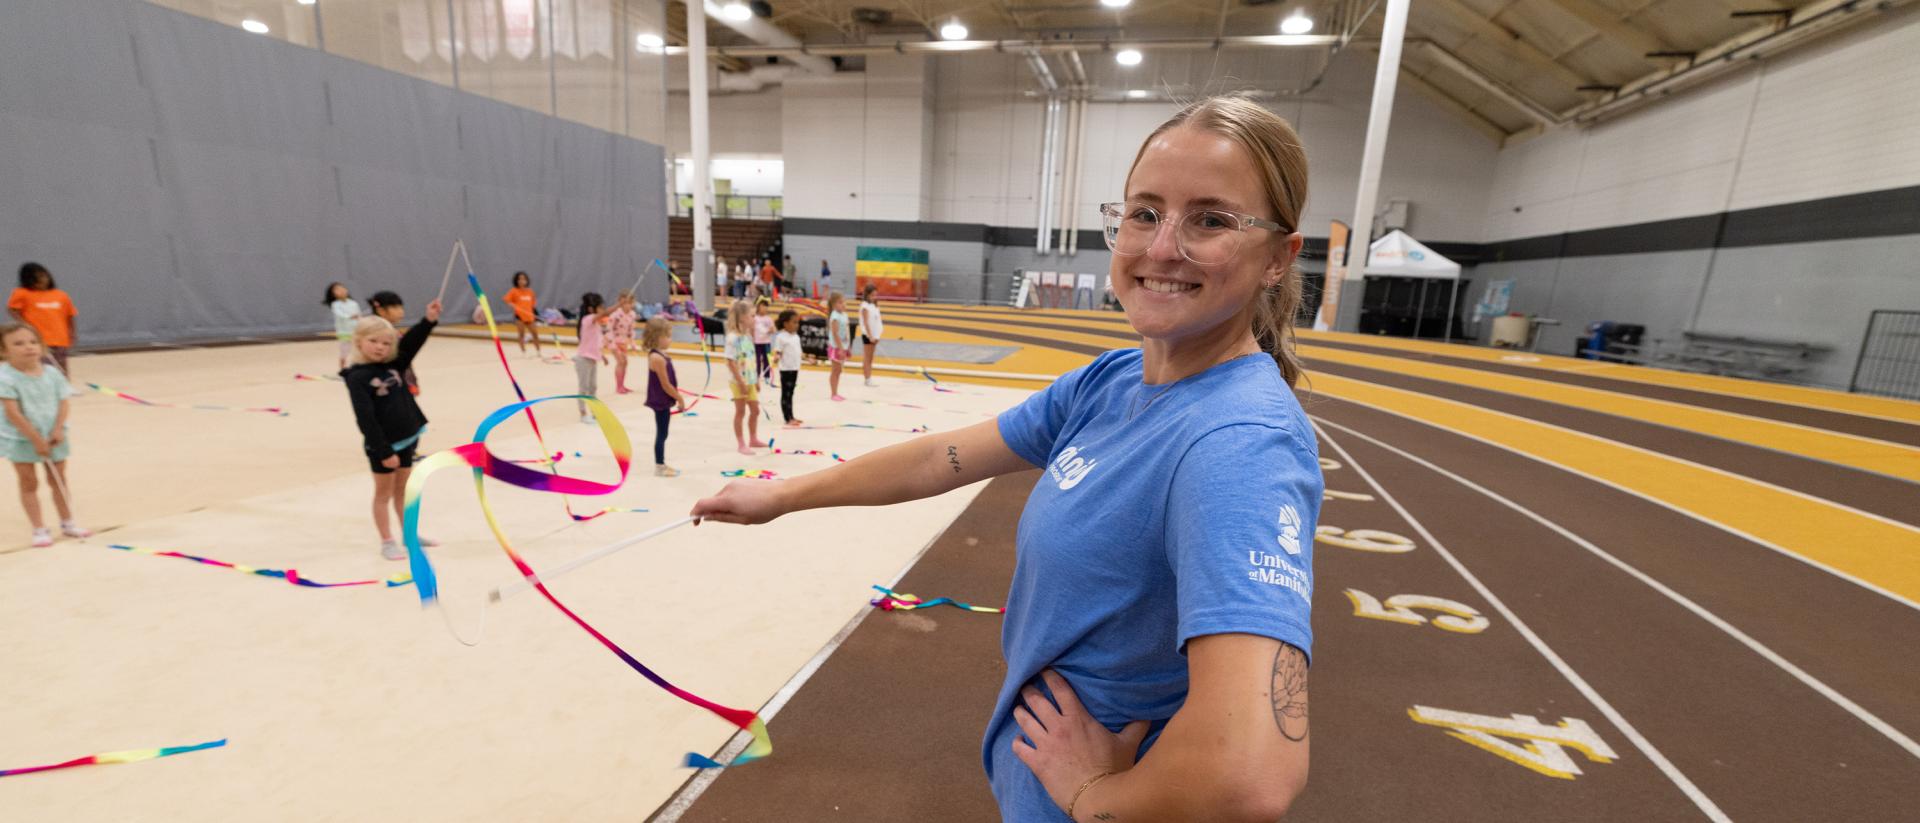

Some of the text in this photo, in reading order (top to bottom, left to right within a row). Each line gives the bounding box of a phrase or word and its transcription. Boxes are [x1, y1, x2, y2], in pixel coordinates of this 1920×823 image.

[1314, 525, 1417, 553] 6
[1343, 588, 1490, 634] 5
[1407, 704, 1619, 780] 4
